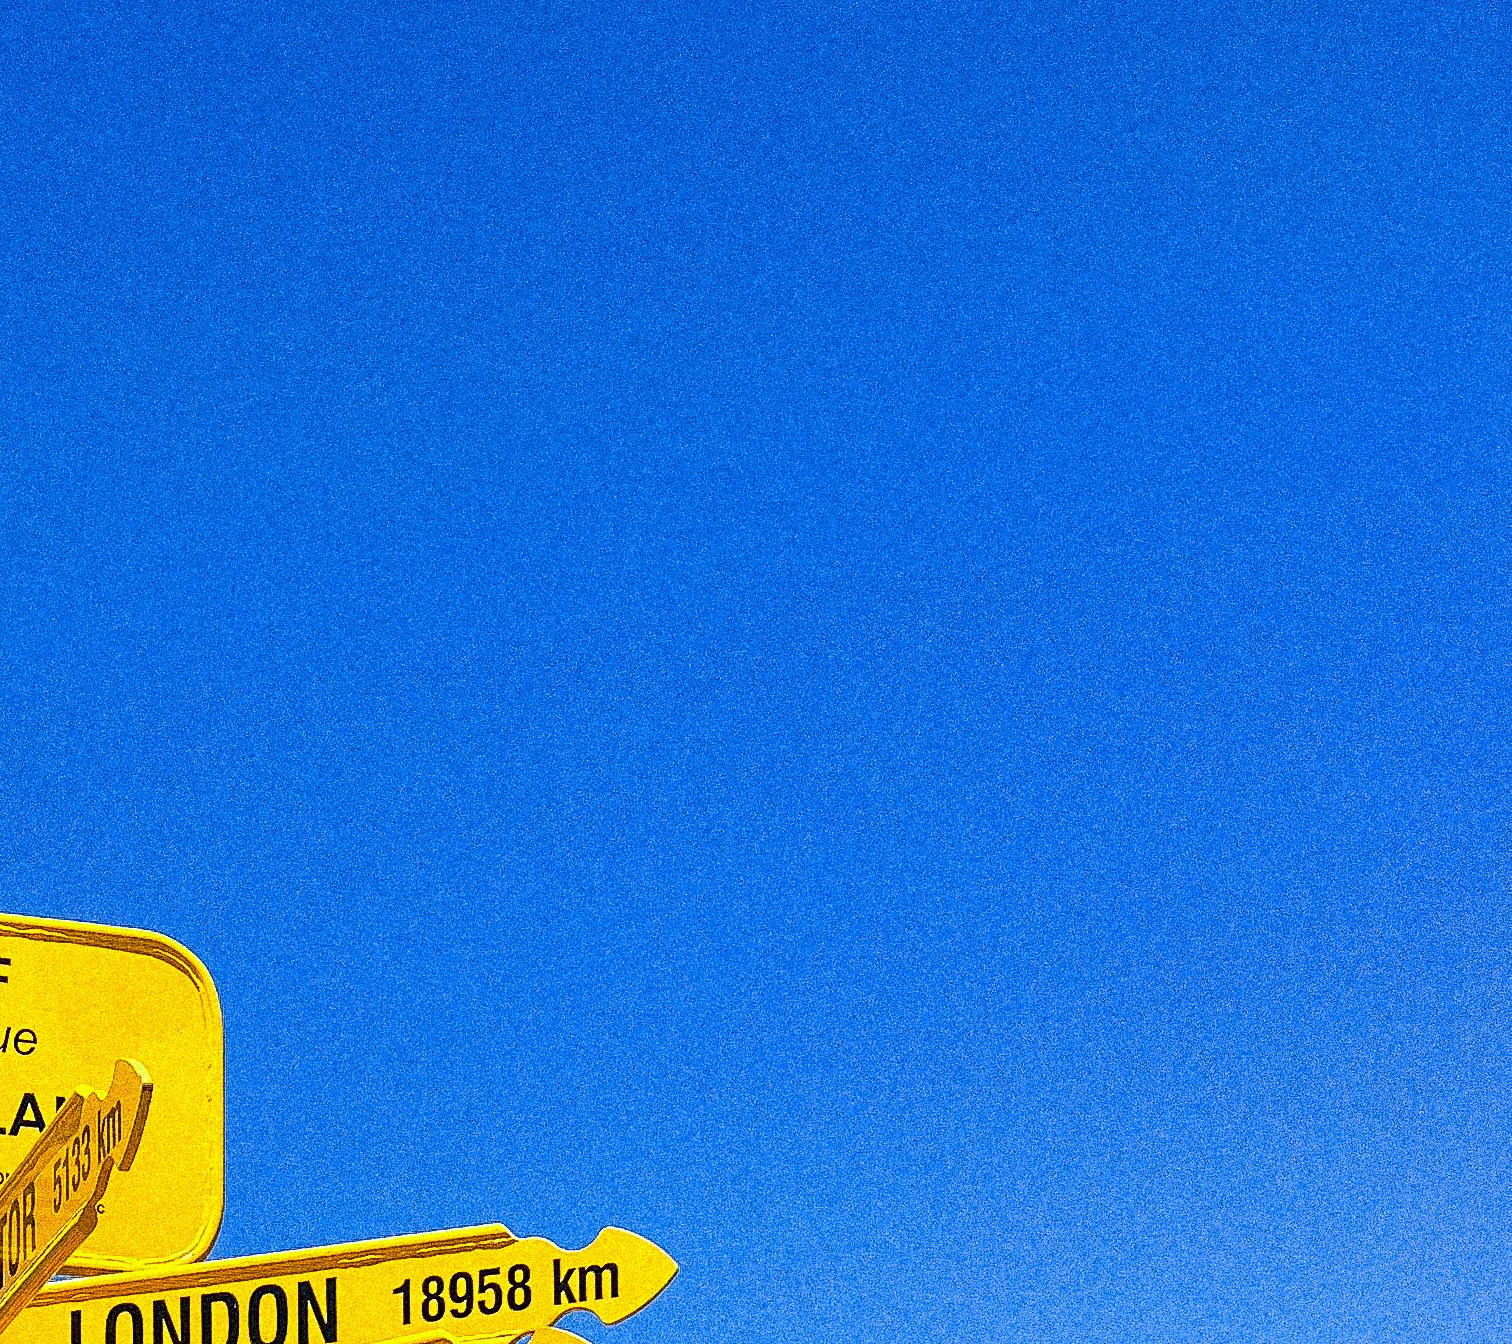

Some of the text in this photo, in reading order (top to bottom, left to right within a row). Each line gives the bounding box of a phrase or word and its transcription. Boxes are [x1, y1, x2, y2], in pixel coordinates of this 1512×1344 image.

[53, 1125, 90, 1213] 5133
[97, 1101, 122, 1165] km
[392, 1263, 532, 1325] 18958
[553, 1258, 620, 1306] km
